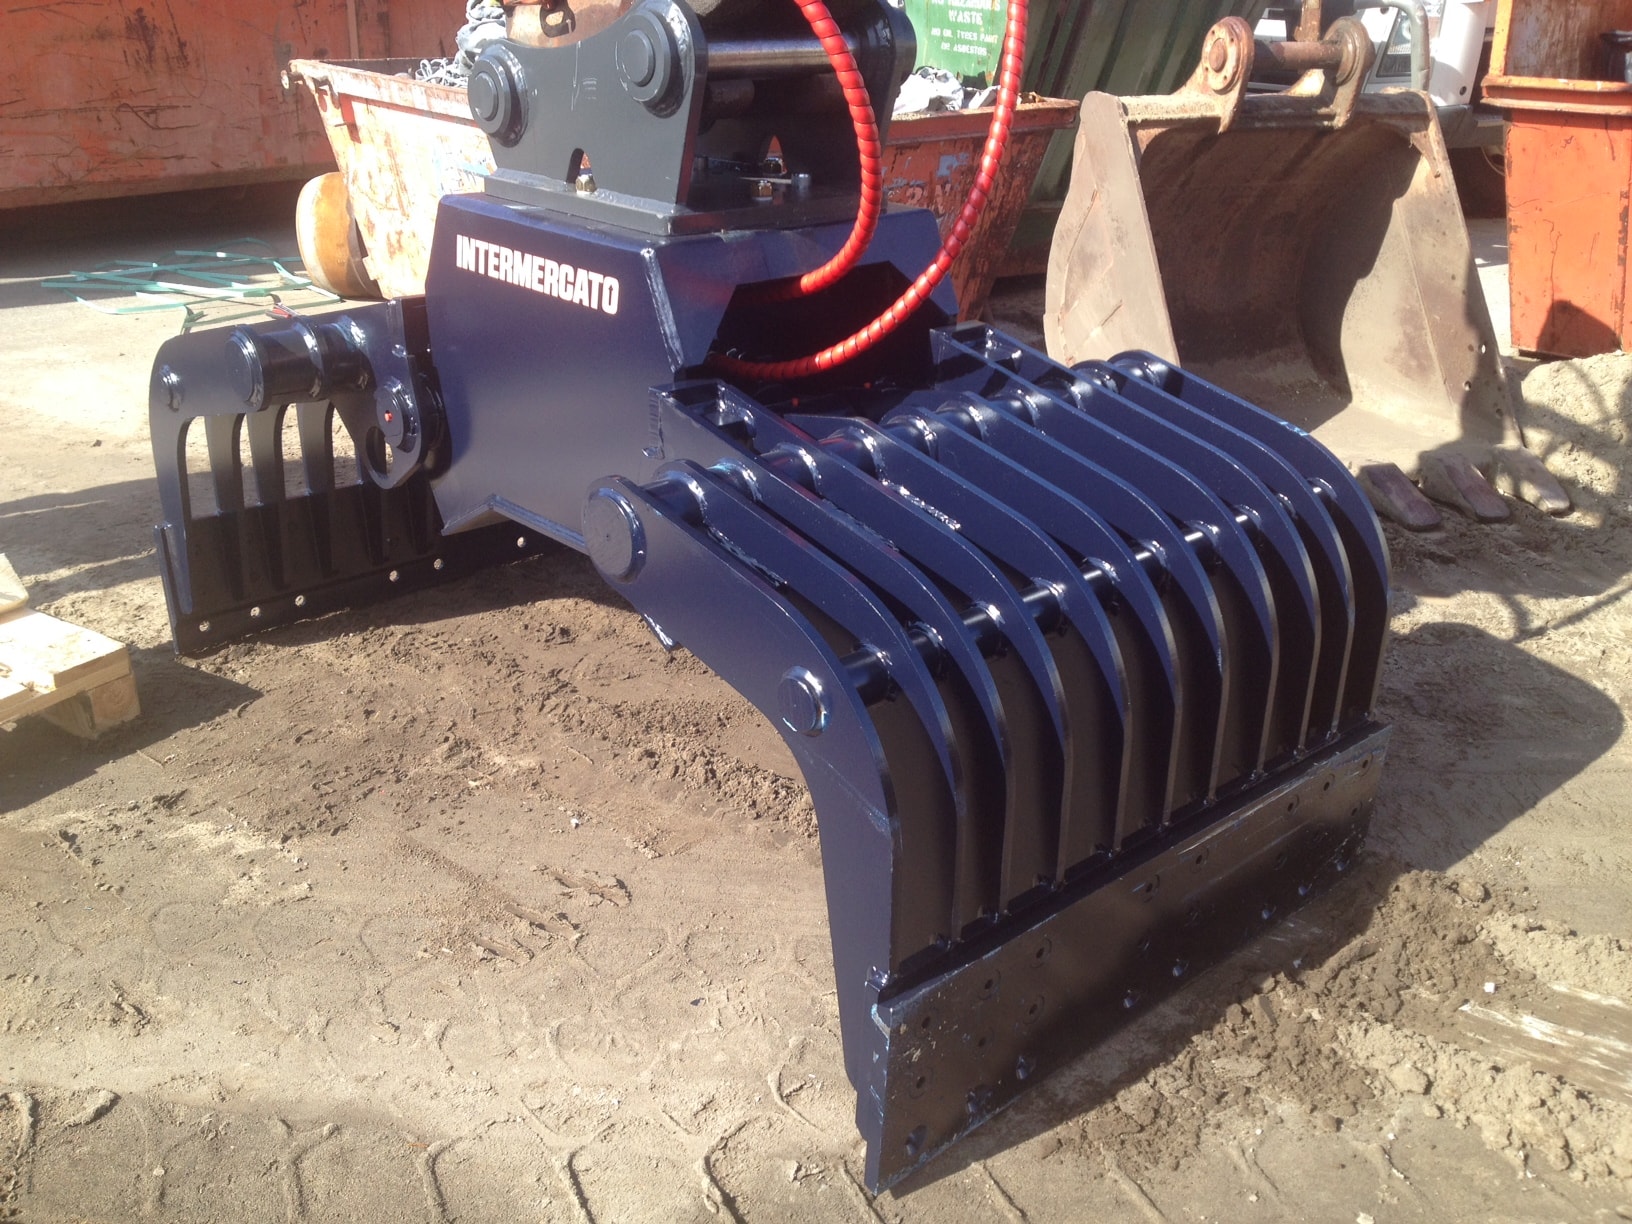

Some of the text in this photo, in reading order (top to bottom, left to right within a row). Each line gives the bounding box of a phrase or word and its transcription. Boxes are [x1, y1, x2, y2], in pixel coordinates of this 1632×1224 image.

[948, 9, 983, 25] WASTE
[953, 43, 987, 56] ASBESTOS
[456, 234, 619, 315] INTERMERCATO
